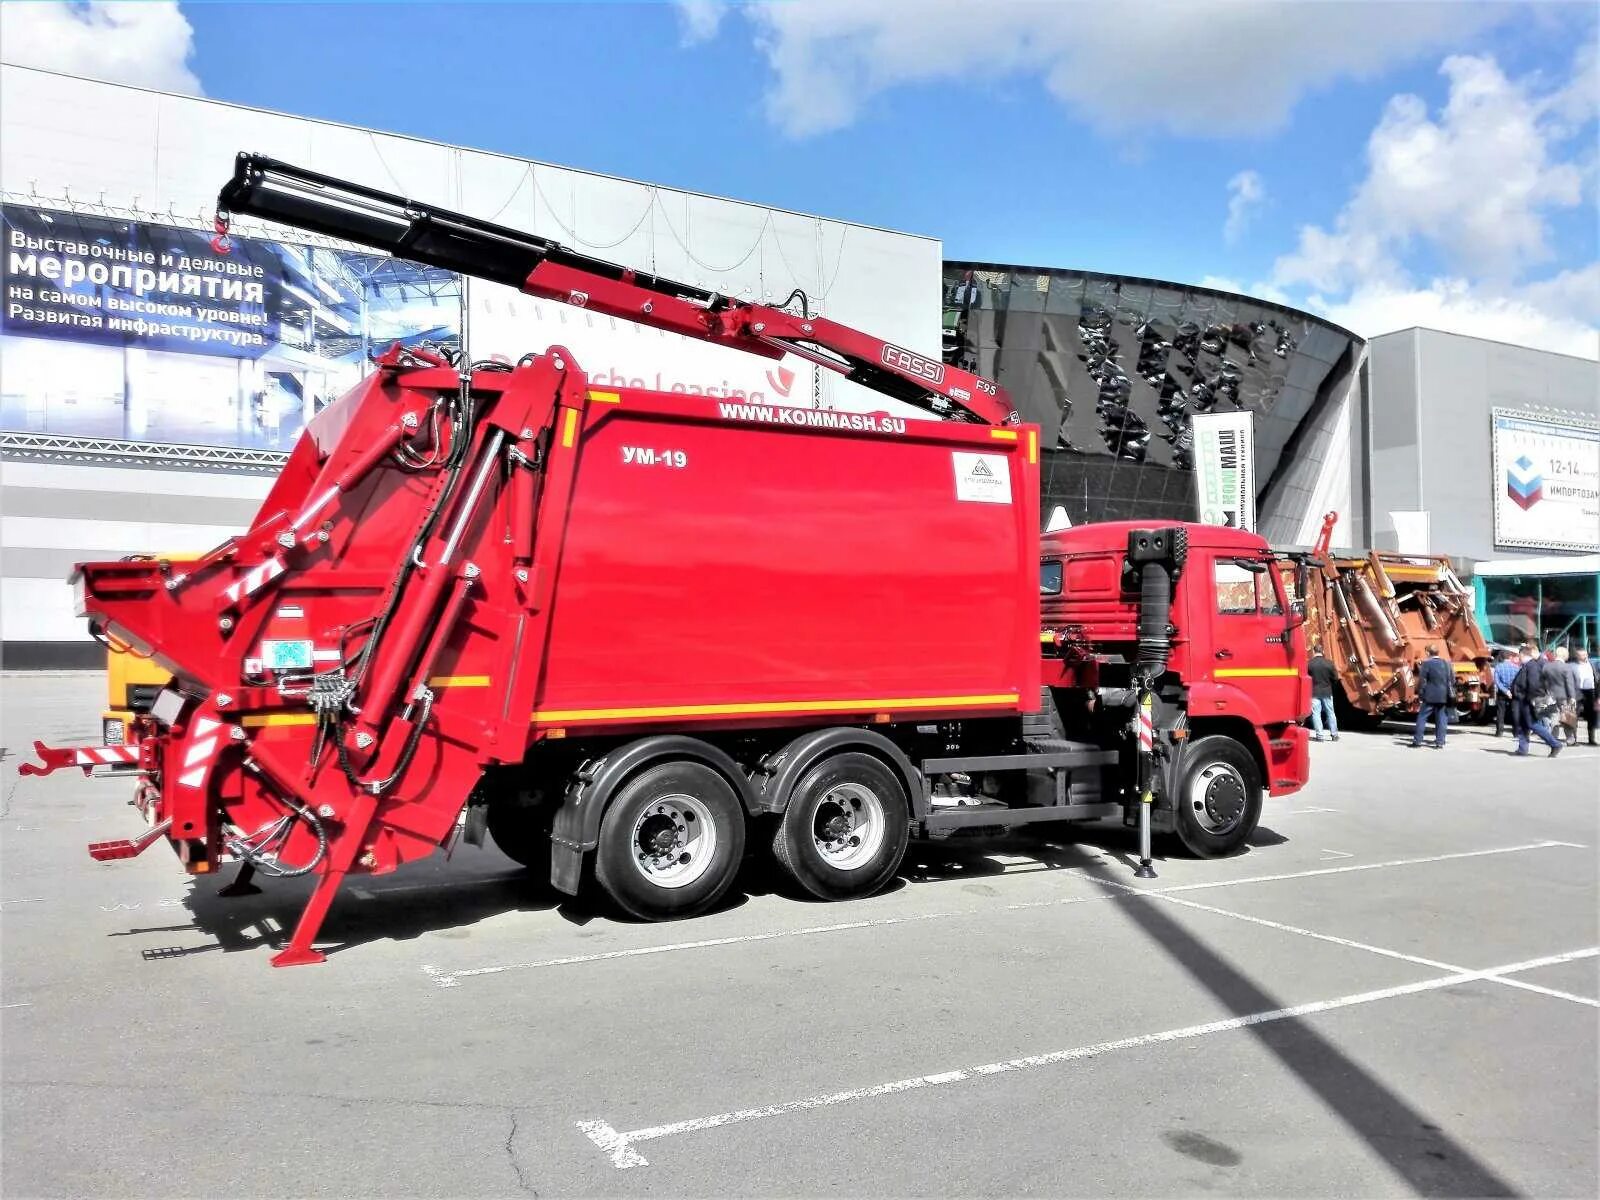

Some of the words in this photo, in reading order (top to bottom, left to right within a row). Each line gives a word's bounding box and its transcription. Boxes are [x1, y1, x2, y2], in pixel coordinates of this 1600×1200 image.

[11, 231, 156, 265] Выставочные
[161, 254, 173, 267] и
[178, 256, 264, 278] деловые
[10, 252, 263, 303] мероприятия
[9, 286, 33, 300] на
[40, 290, 101, 308] самом
[107, 297, 192, 317] высоком
[197, 307, 268, 326] уровне!
[9, 303, 103, 328] Развитая
[108, 317, 268, 346] инфраструктура.
[885, 346, 941, 381] FASSI
[975, 379, 997, 396] F95
[719, 402, 906, 434] WWW.KOMMASH.SU
[622, 446, 687, 468] УМ-19
[1549, 459, 1580, 476] 12-14
